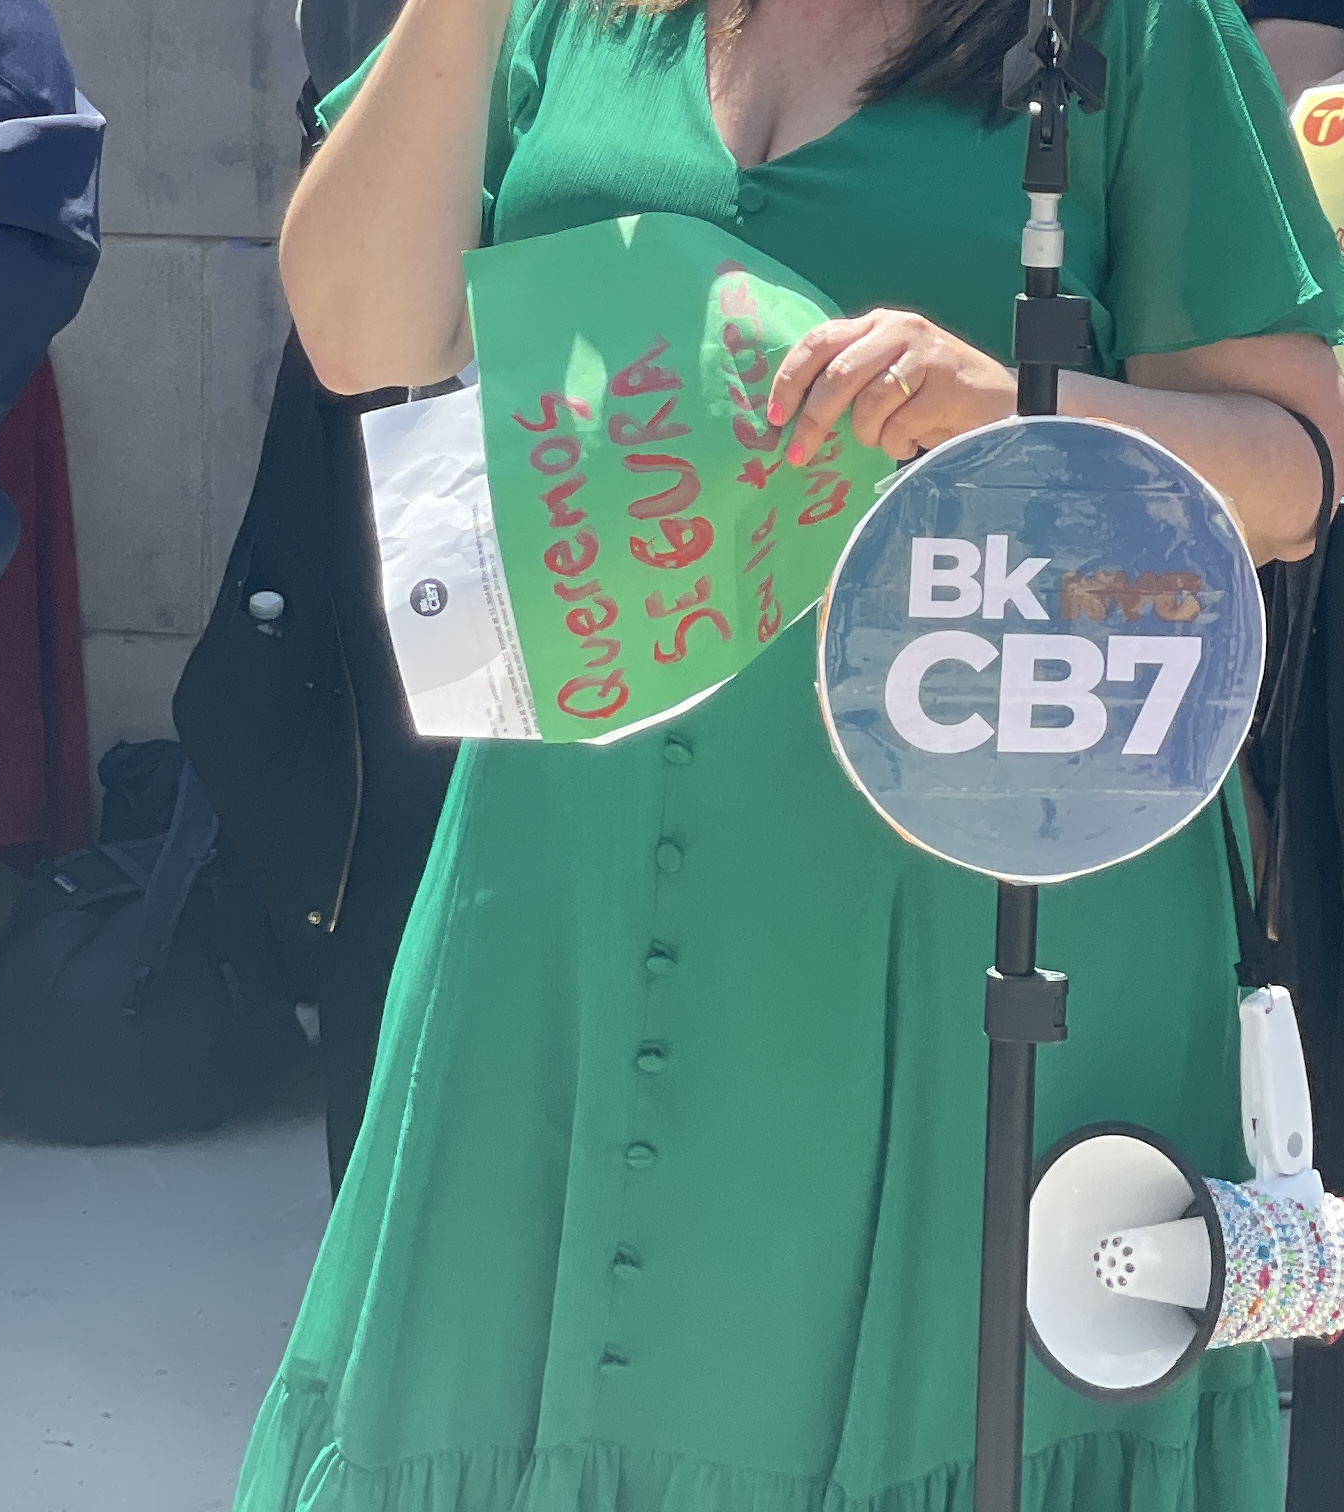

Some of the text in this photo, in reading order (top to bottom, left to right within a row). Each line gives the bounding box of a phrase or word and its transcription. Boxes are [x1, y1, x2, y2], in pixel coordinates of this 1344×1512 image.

[424, 581, 441, 611] CB7
[908, 534, 1052, 620] Bk
[884, 630, 1202, 755] CB7
